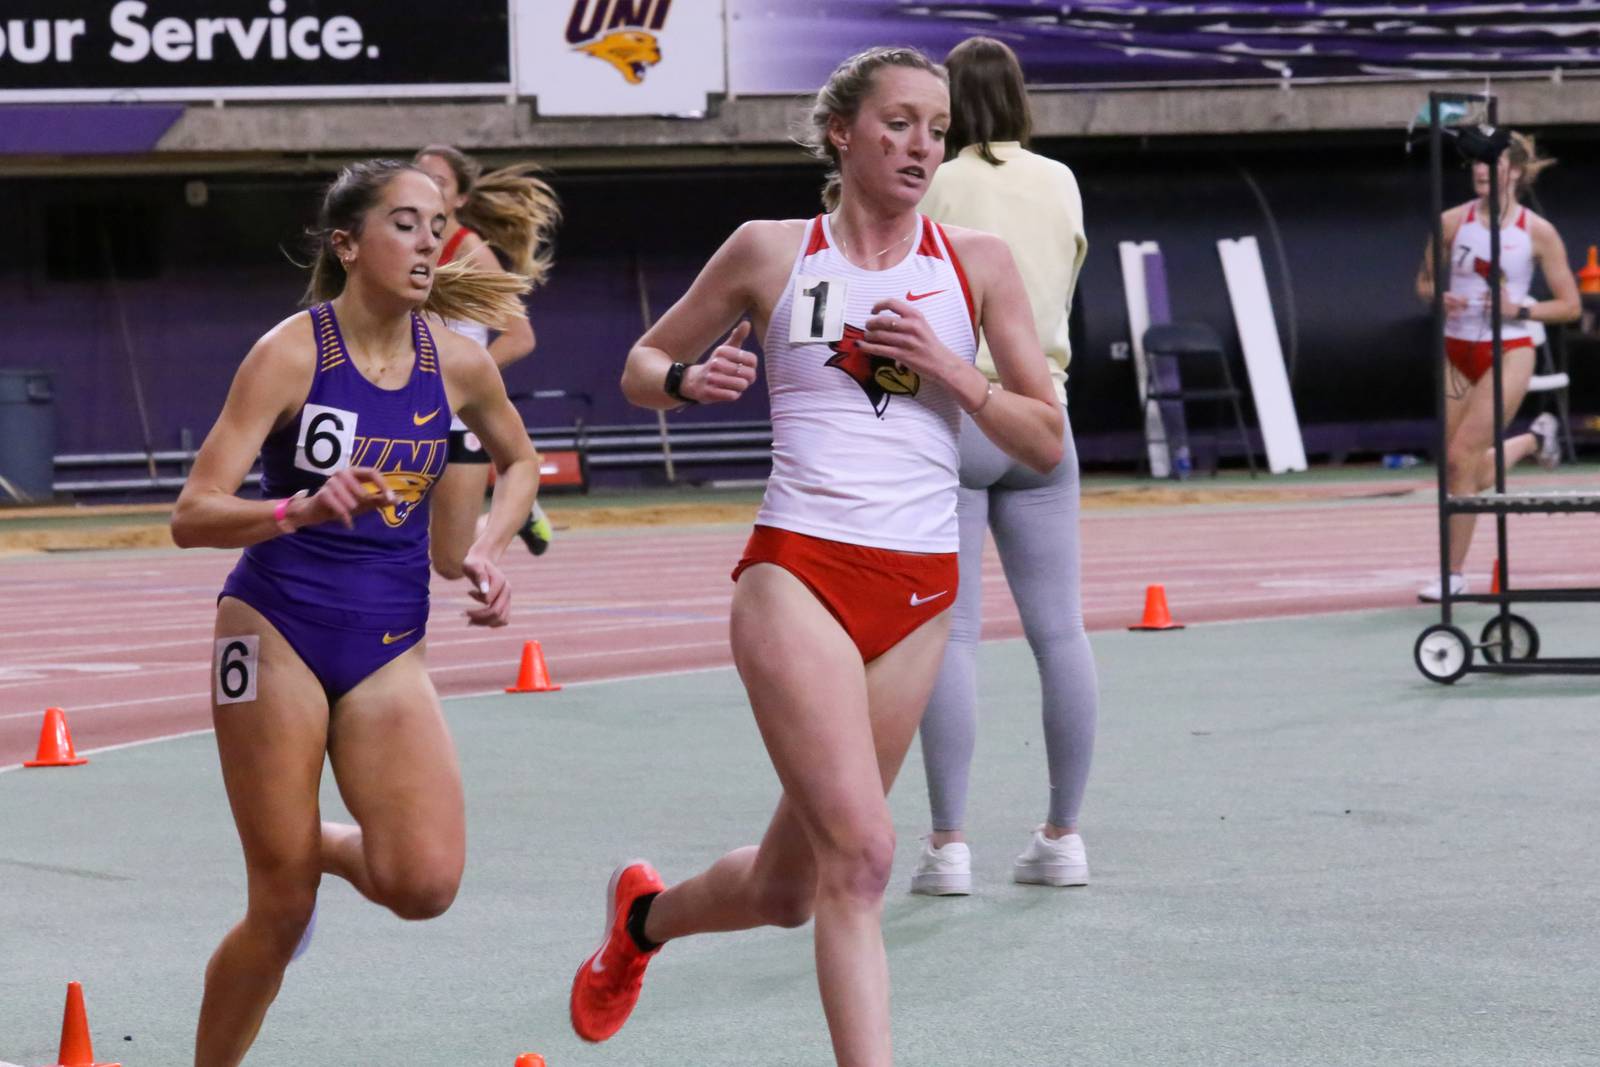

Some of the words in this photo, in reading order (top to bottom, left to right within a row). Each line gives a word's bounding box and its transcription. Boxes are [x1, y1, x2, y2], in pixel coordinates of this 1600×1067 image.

[0, 17, 85, 63] ur
[110, 0, 379, 62] Service.
[565, 0, 671, 44] UNI
[1457, 244, 1472, 268] 7
[802, 281, 829, 338] 1
[304, 412, 345, 470] 6
[220, 640, 249, 699] 6
